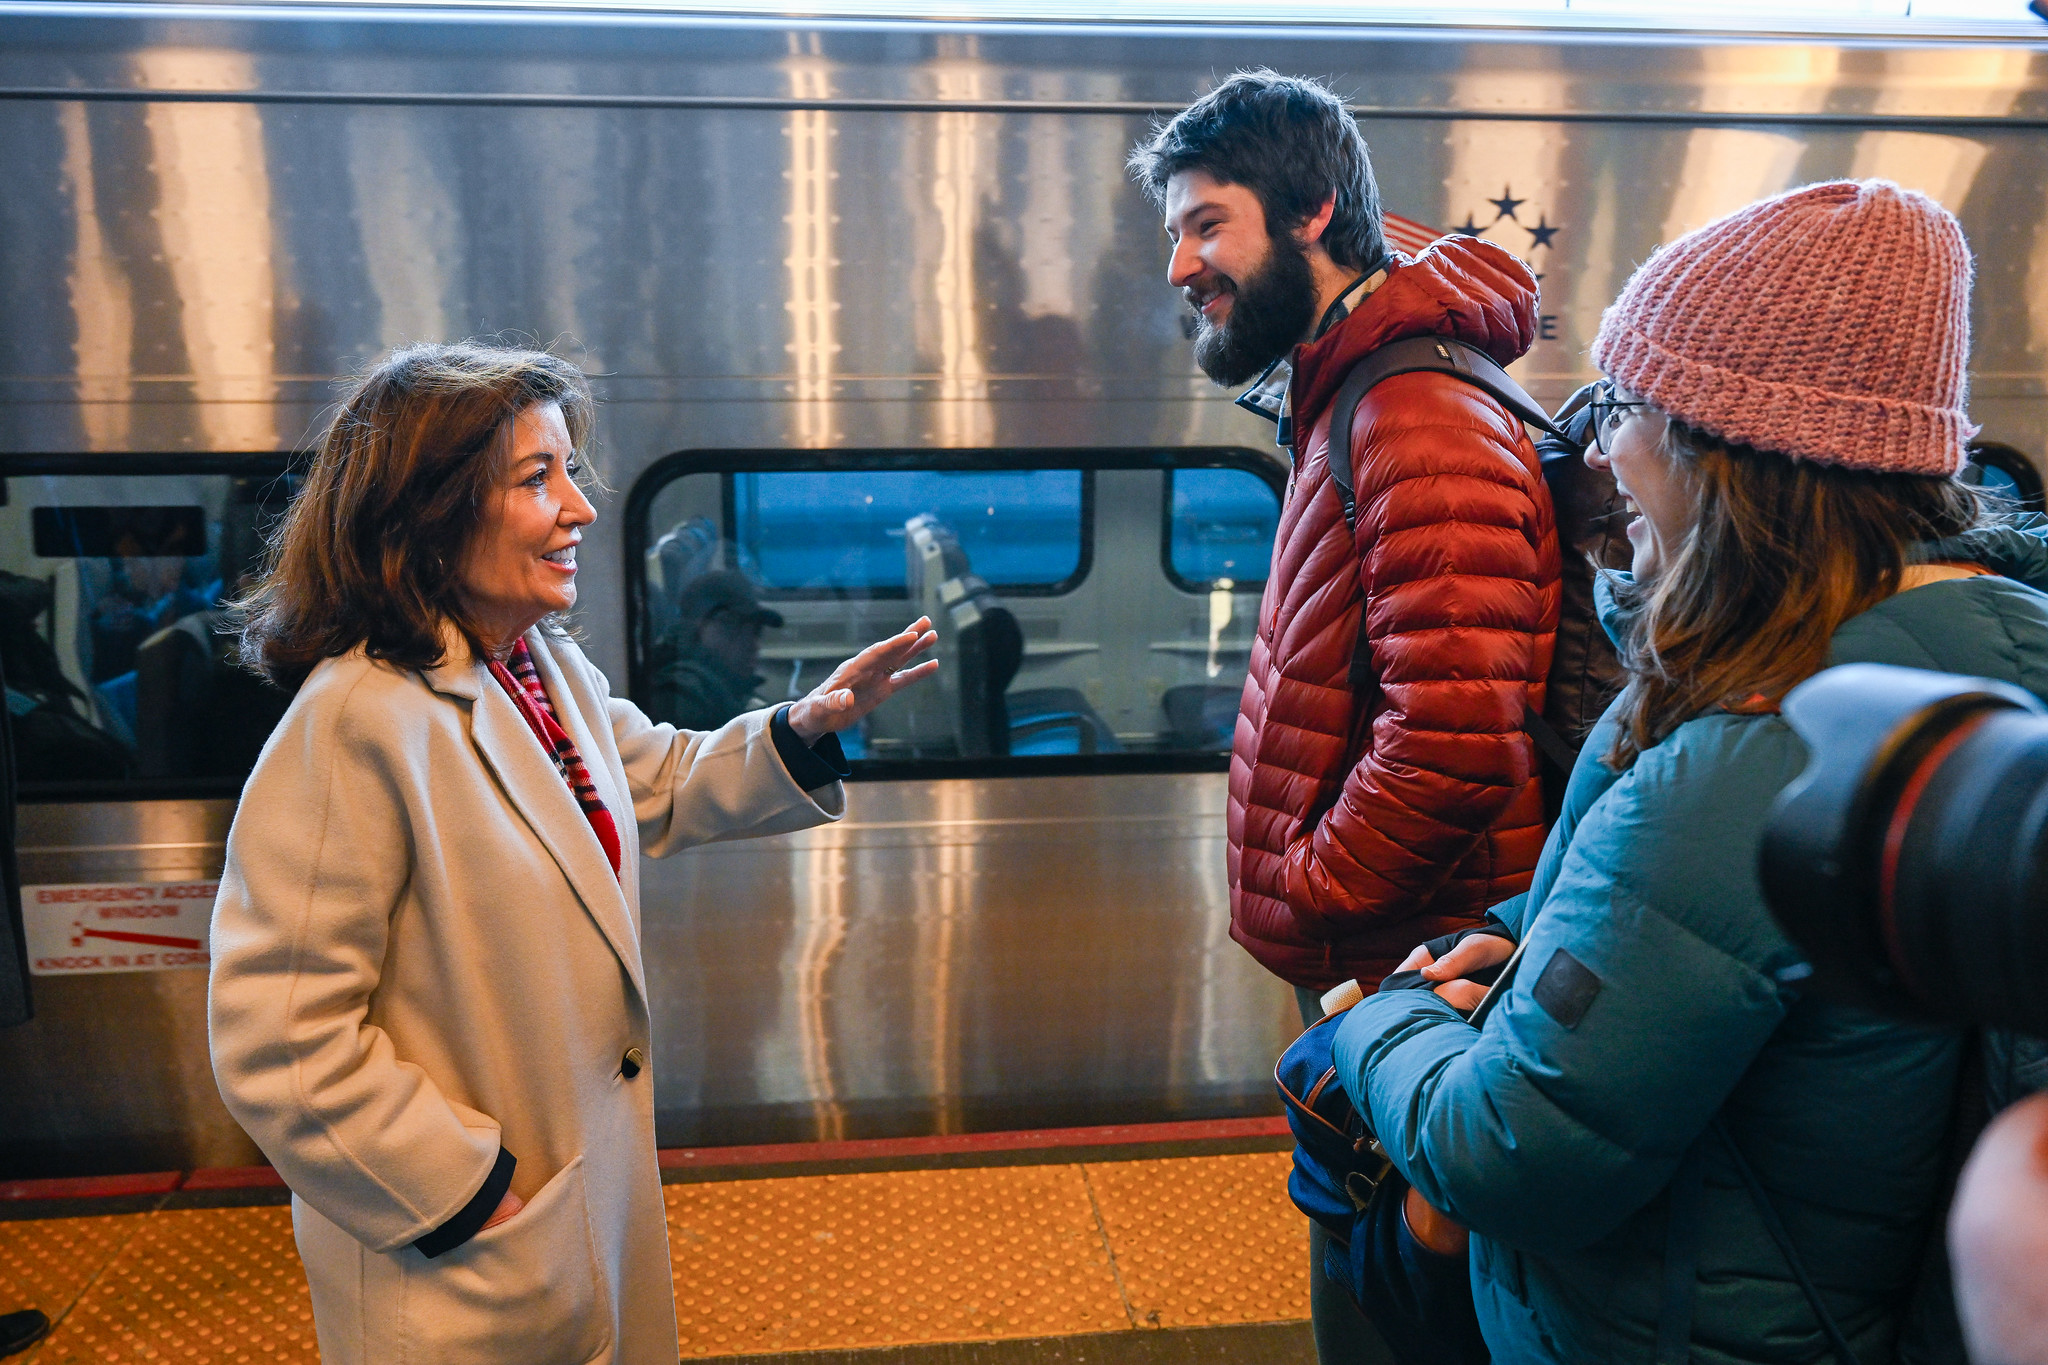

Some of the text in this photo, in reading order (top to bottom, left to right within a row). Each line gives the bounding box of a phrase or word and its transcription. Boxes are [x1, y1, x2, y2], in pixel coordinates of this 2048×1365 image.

[36, 886, 156, 904] EMERGENCY
[98, 904, 179, 919] WINDOW
[35, 955, 102, 969] KNOCK
[109, 954, 129, 967] IN
[134, 953, 156, 966] AT
